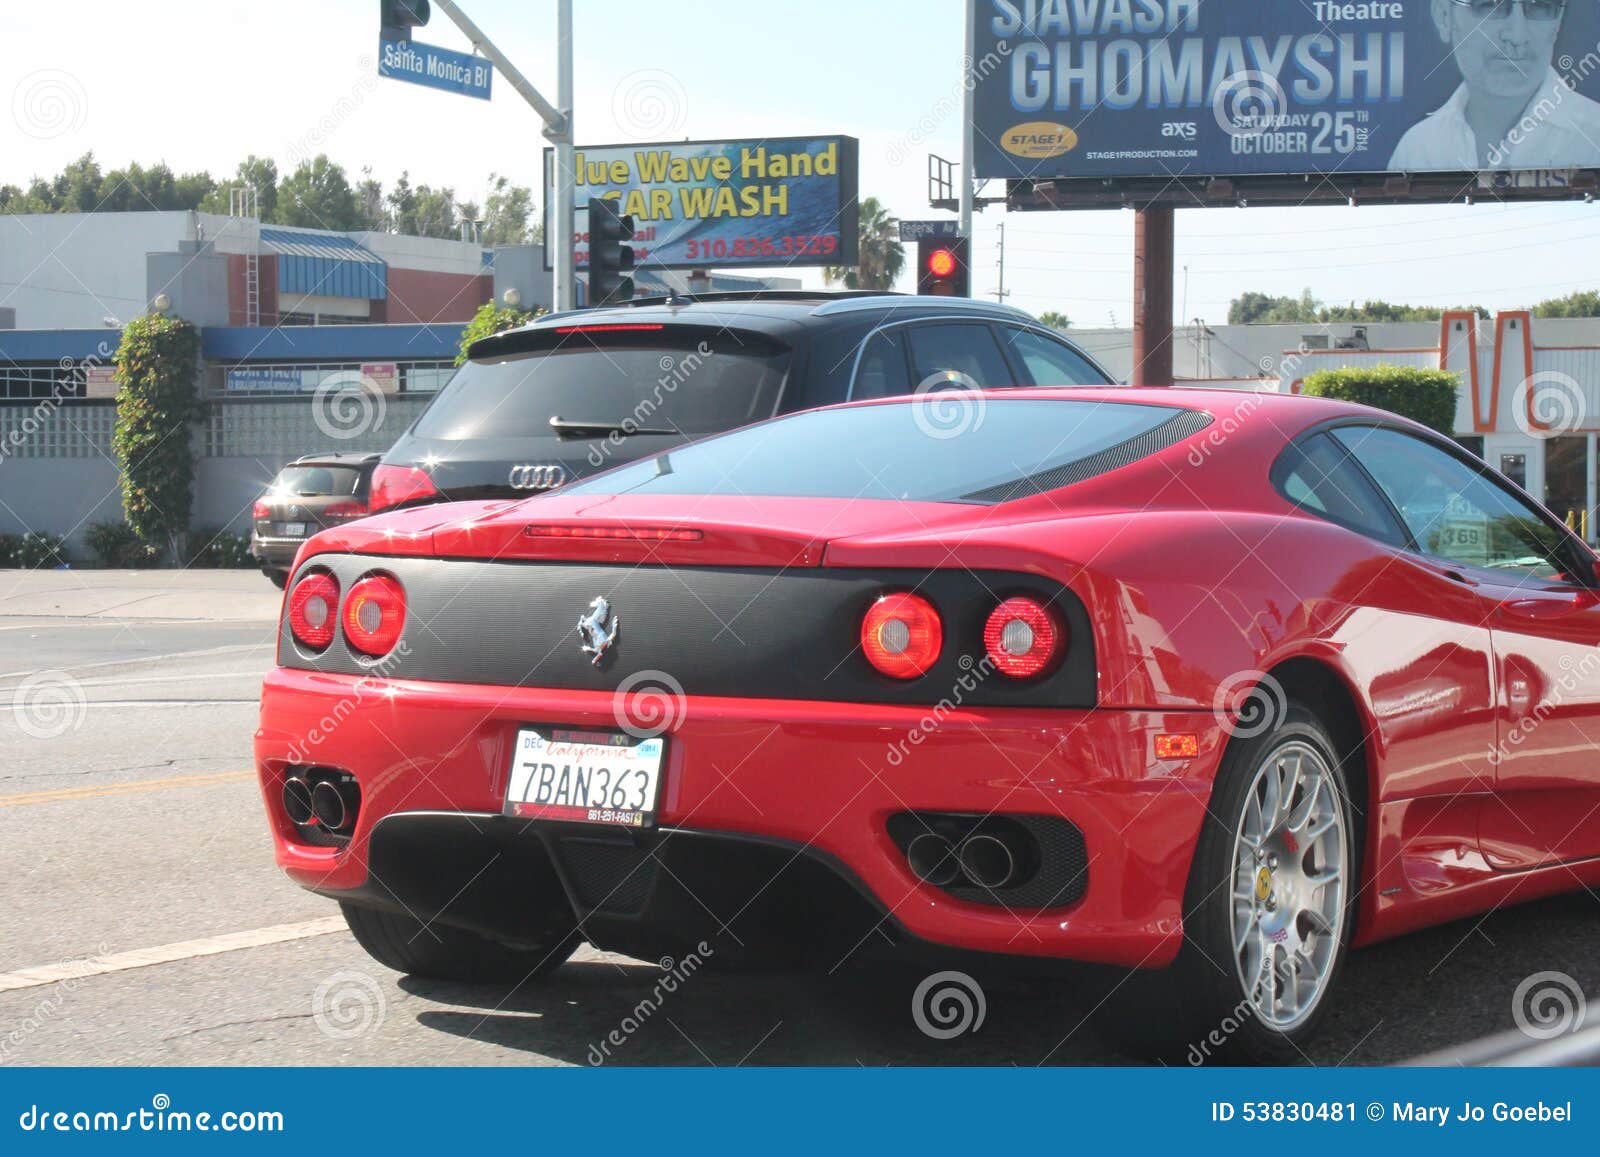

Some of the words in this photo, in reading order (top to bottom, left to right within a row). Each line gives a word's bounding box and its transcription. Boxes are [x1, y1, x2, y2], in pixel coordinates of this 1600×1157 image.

[1312, 0, 1404, 21] Theatre
[384, 44, 424, 73] Santa
[427, 54, 472, 85] Monica
[474, 65, 488, 88] Bl
[1010, 32, 1404, 111] GHOMAYSHI
[1231, 132, 1307, 154] OCTOBER
[1311, 111, 1355, 154] 25
[1232, 114, 1310, 128] SATURDAY
[1010, 134, 1064, 145] STAGE1
[574, 152, 629, 186] lue
[634, 150, 732, 183] Wave
[740, 142, 837, 178] Hand
[1087, 150, 1198, 159] STAGE1PRODUCTION.COM
[680, 185, 790, 220] WASH
[686, 234, 837, 259] 310.826.3529
[524, 737, 543, 749] DEC
[546, 741, 637, 764] California
[523, 762, 650, 810] 7BAN363
